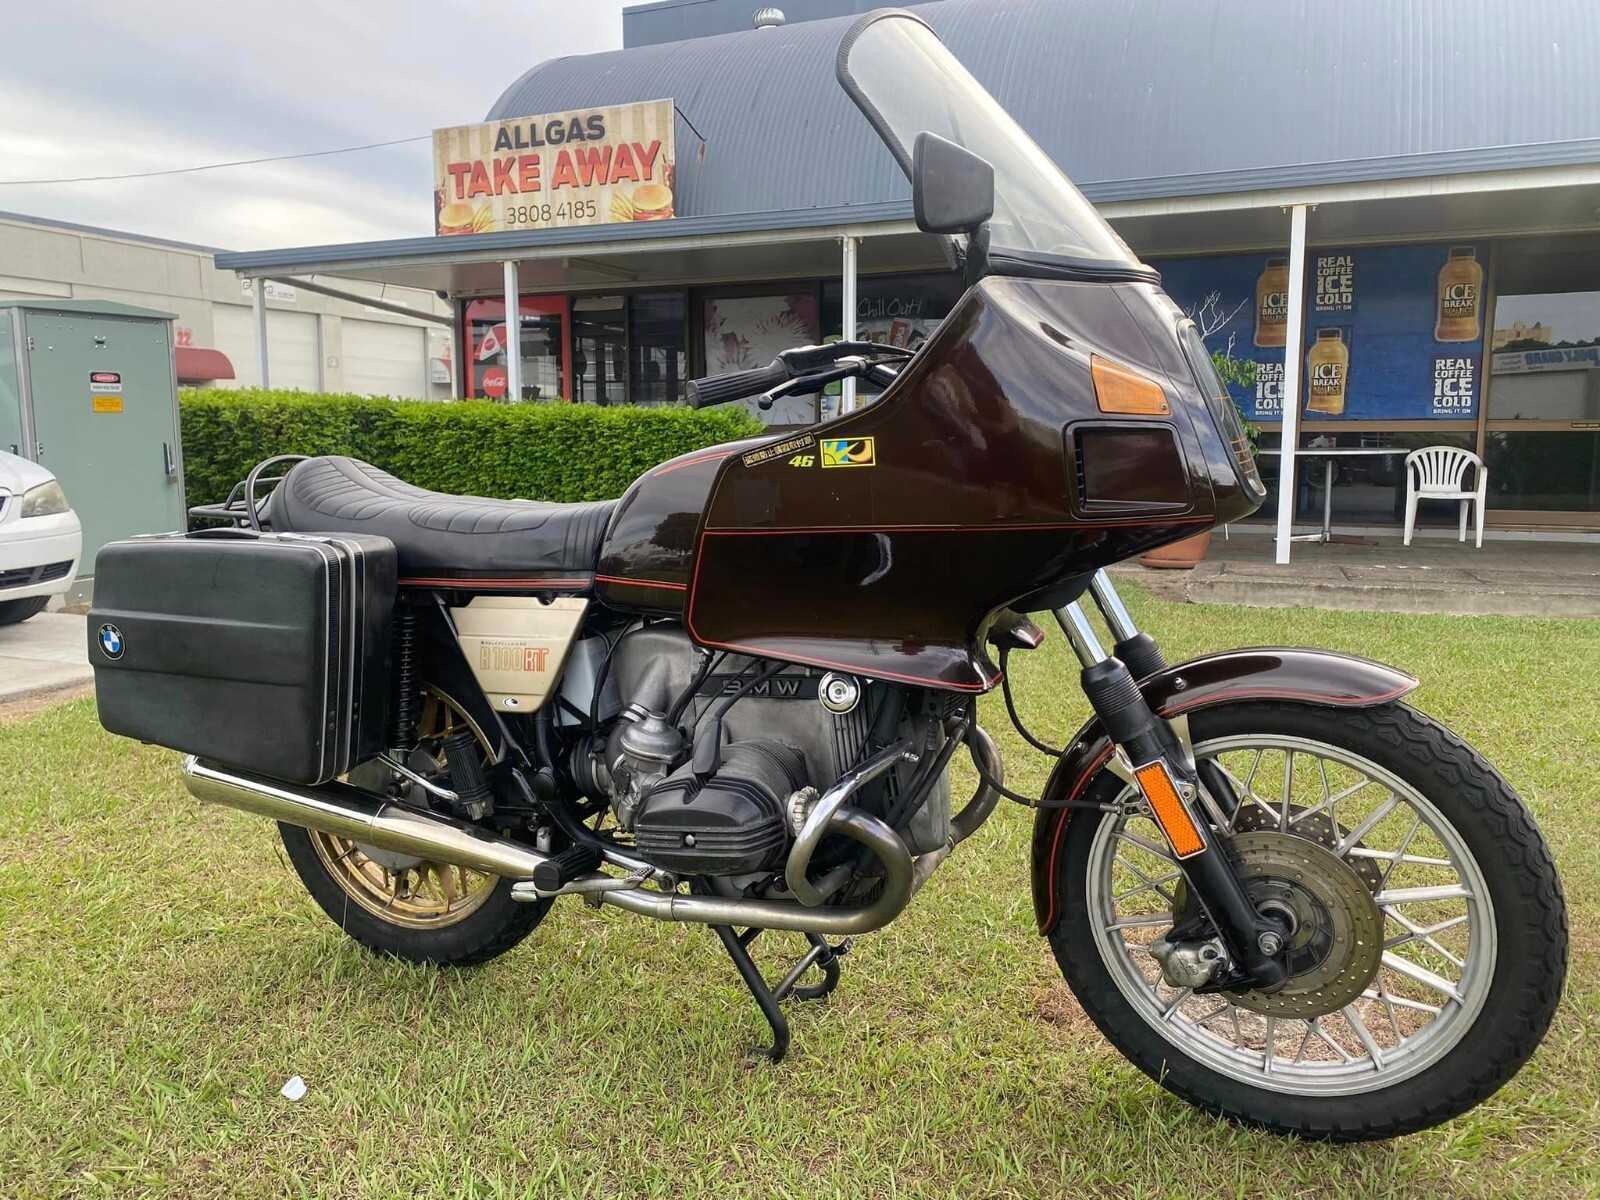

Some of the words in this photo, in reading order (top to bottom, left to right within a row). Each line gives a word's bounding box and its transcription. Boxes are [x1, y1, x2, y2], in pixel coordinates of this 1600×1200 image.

[494, 115, 605, 151] ALLGAS
[447, 153, 541, 199] TAKE
[551, 140, 662, 190] AWAY
[507, 204, 551, 225] 3808
[556, 200, 597, 220] 4185
[1317, 255, 1354, 268] REAL
[1317, 267, 1353, 276] COFFEE
[1317, 275, 1353, 294] ICE
[1444, 284, 1475, 300] ICE
[1316, 293, 1352, 305] COLD
[1444, 299, 1474, 308] BREAK
[857, 299, 885, 317] Chill
[177, 330, 191, 346] 22
[1256, 363, 1284, 374] REA
[1435, 358, 1474, 370] REAL
[1313, 363, 1342, 379] ICE
[1434, 369, 1473, 378] COFFEE
[1256, 374, 1285, 382] COFFE
[1313, 378, 1341, 386] BREAK
[1434, 378, 1473, 396] ICE
[1433, 396, 1472, 408] COLD
[788, 455, 815, 468] 46
[722, 680, 800, 695] BMW
